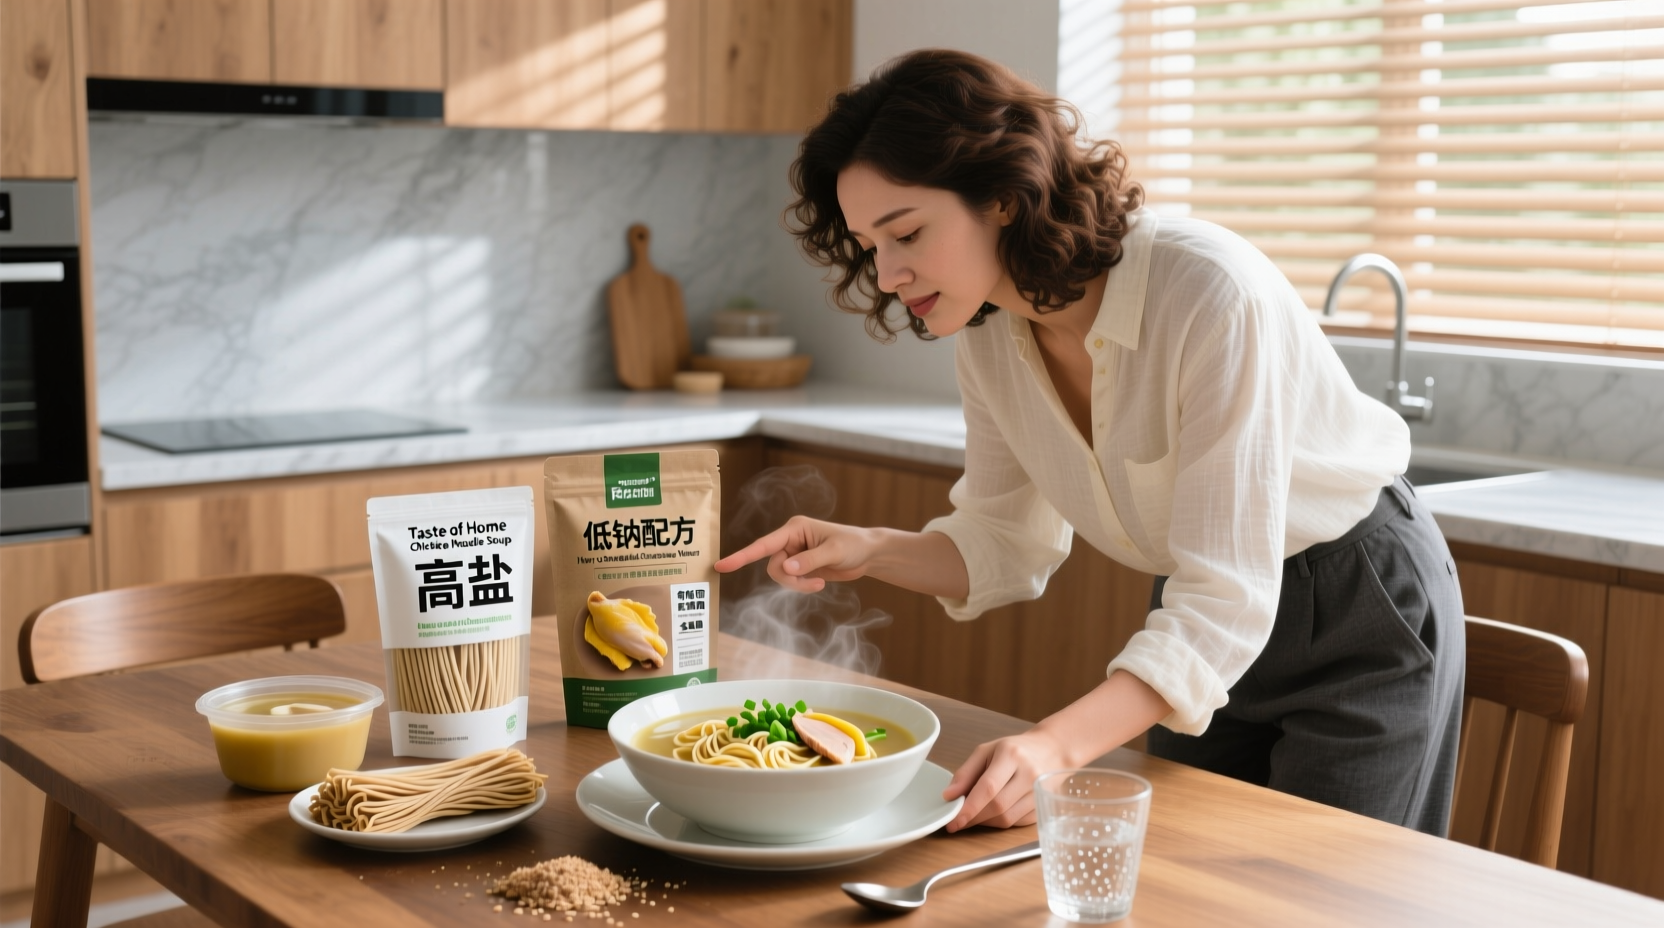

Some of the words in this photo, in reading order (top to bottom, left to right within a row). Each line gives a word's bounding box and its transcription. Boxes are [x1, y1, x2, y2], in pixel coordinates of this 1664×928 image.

[408, 526, 447, 540] Taste
[450, 522, 463, 536] of
[466, 521, 507, 535] Home
[486, 536, 512, 547] Soup
[583, 516, 696, 551] 低钠配方
[415, 553, 514, 613] 高盐
